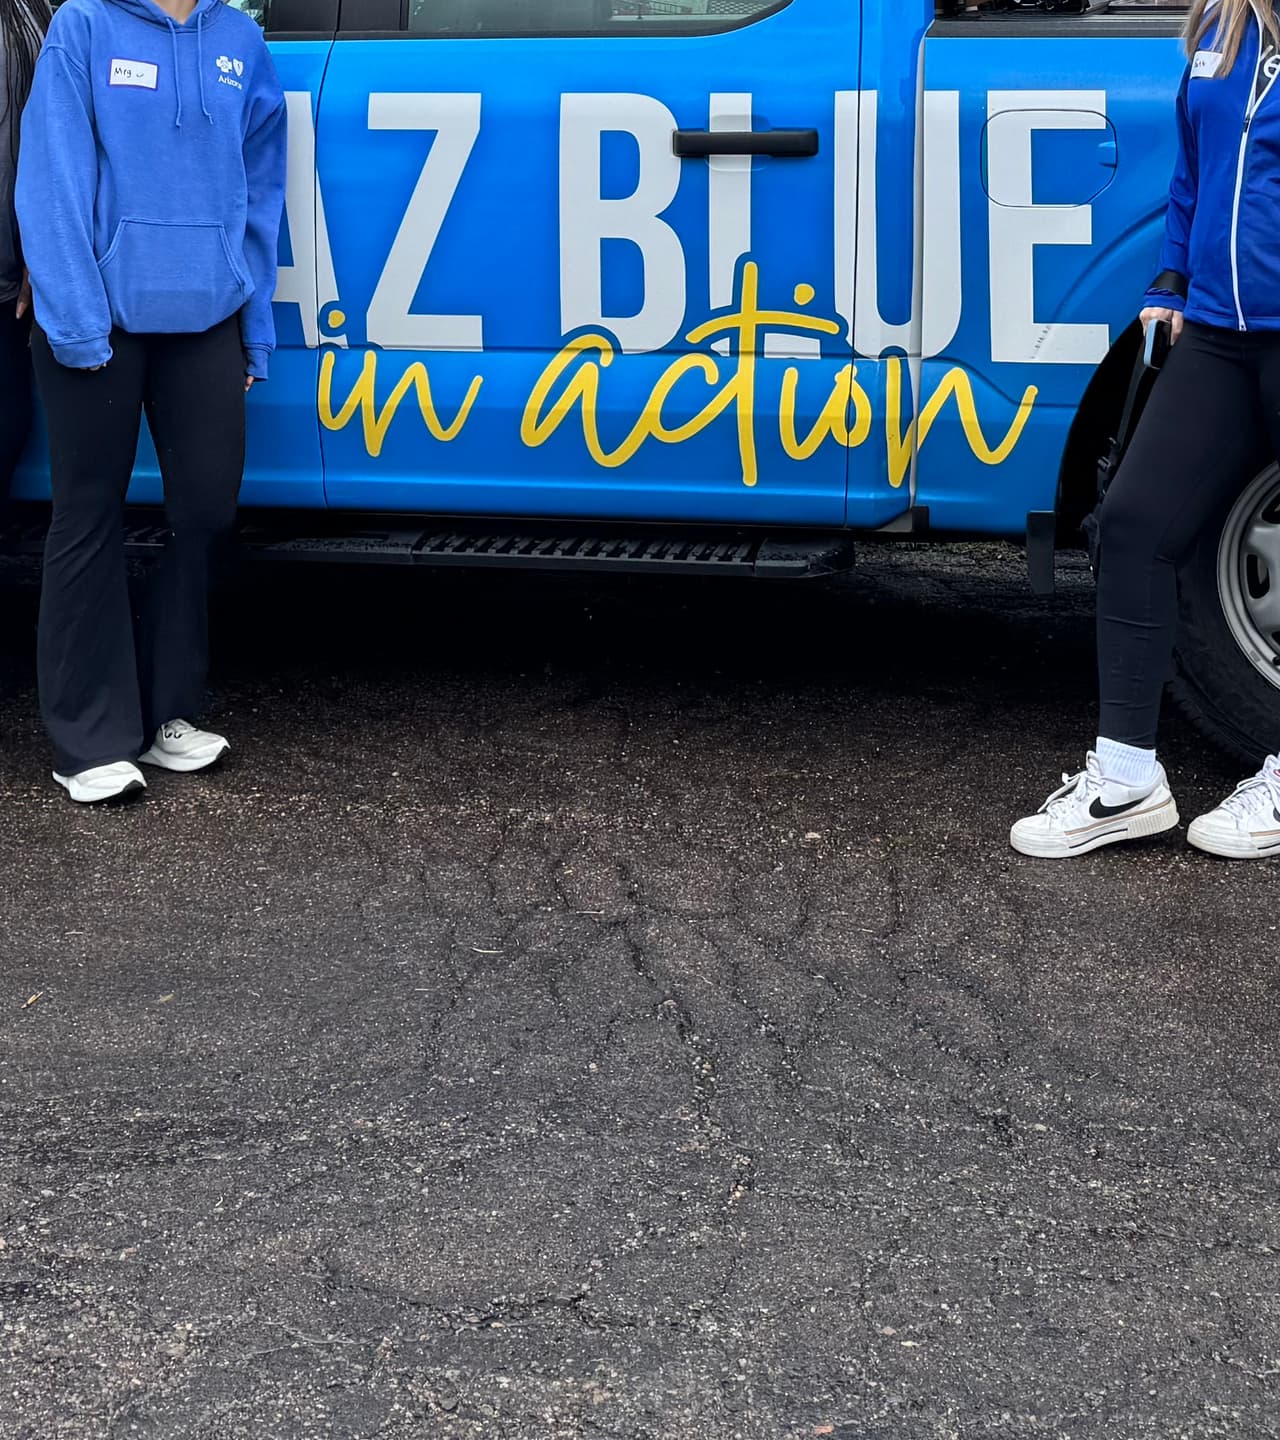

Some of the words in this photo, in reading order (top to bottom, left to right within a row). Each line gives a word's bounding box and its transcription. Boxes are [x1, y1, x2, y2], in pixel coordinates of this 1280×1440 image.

[271, 91, 483, 352] AZ
[560, 90, 1110, 364] BLUE
[318, 310, 483, 457] in
[520, 262, 1037, 487] action
